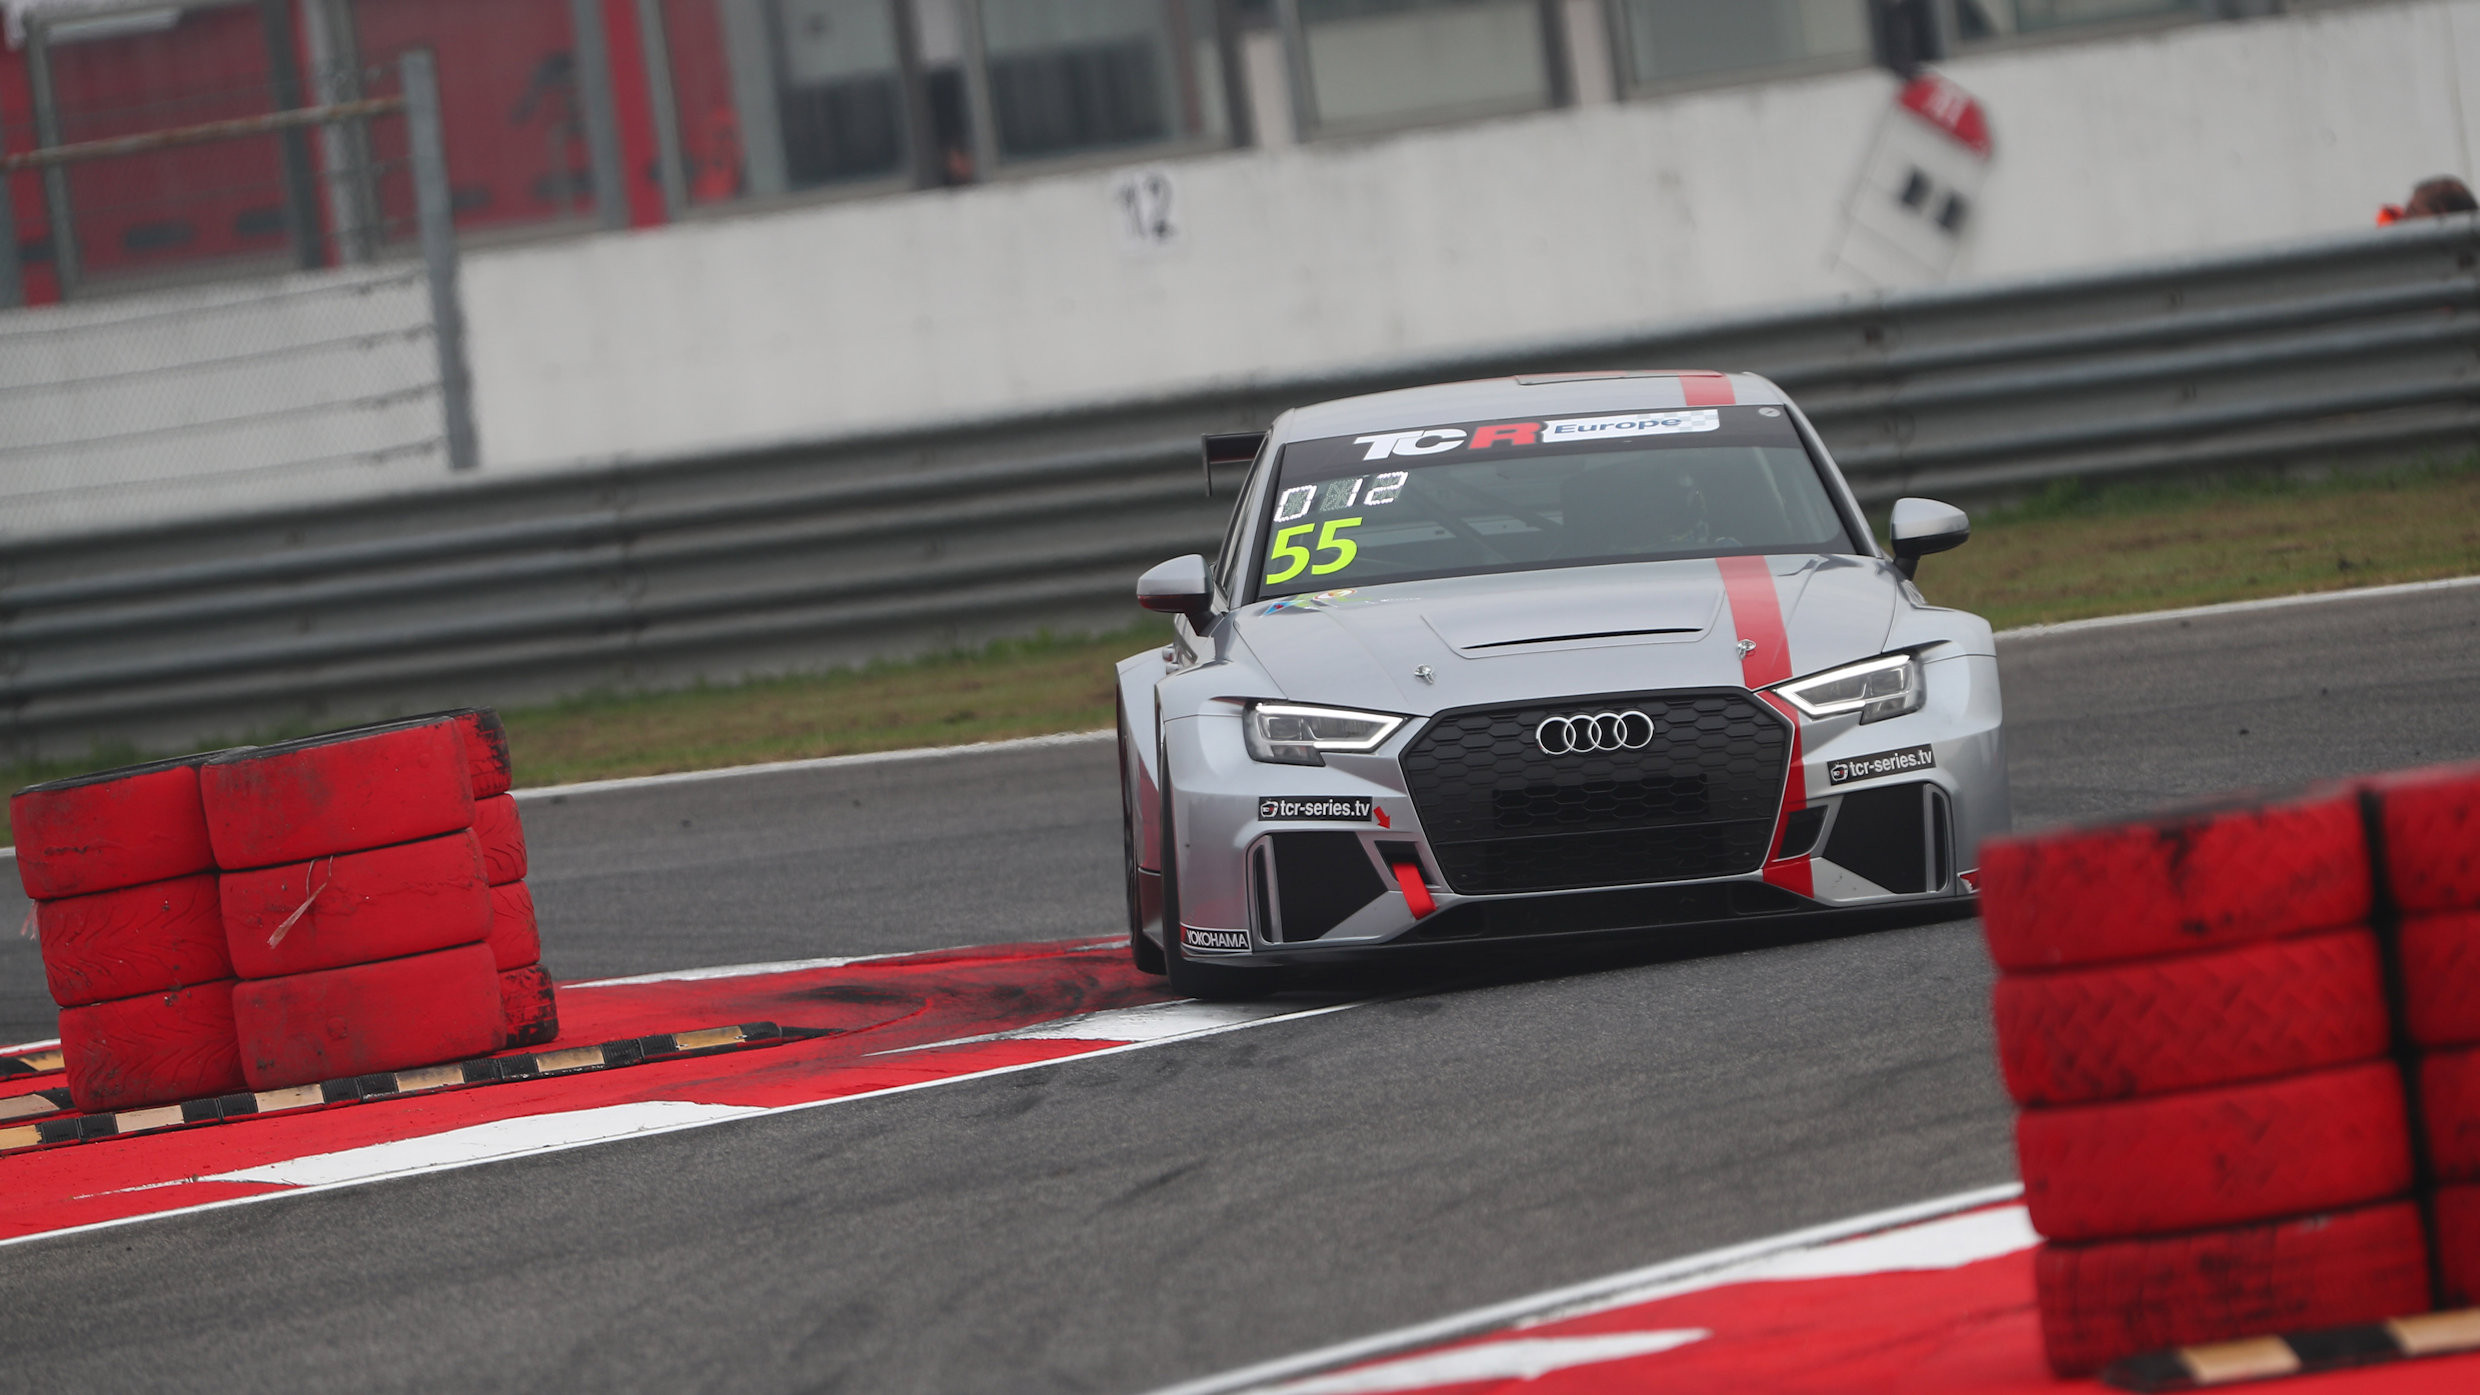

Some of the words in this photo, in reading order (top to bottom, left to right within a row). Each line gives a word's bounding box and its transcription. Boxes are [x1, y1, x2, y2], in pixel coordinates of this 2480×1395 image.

[1354, 422, 1542, 461] TCR
[1554, 416, 1682, 435] Europe
[1266, 517, 1363, 585] 55
[1849, 749, 1932, 777] tcr-series.tv
[1280, 799, 1370, 816] tcr-series.tv
[1186, 929, 1249, 947] YOKOHAMA
